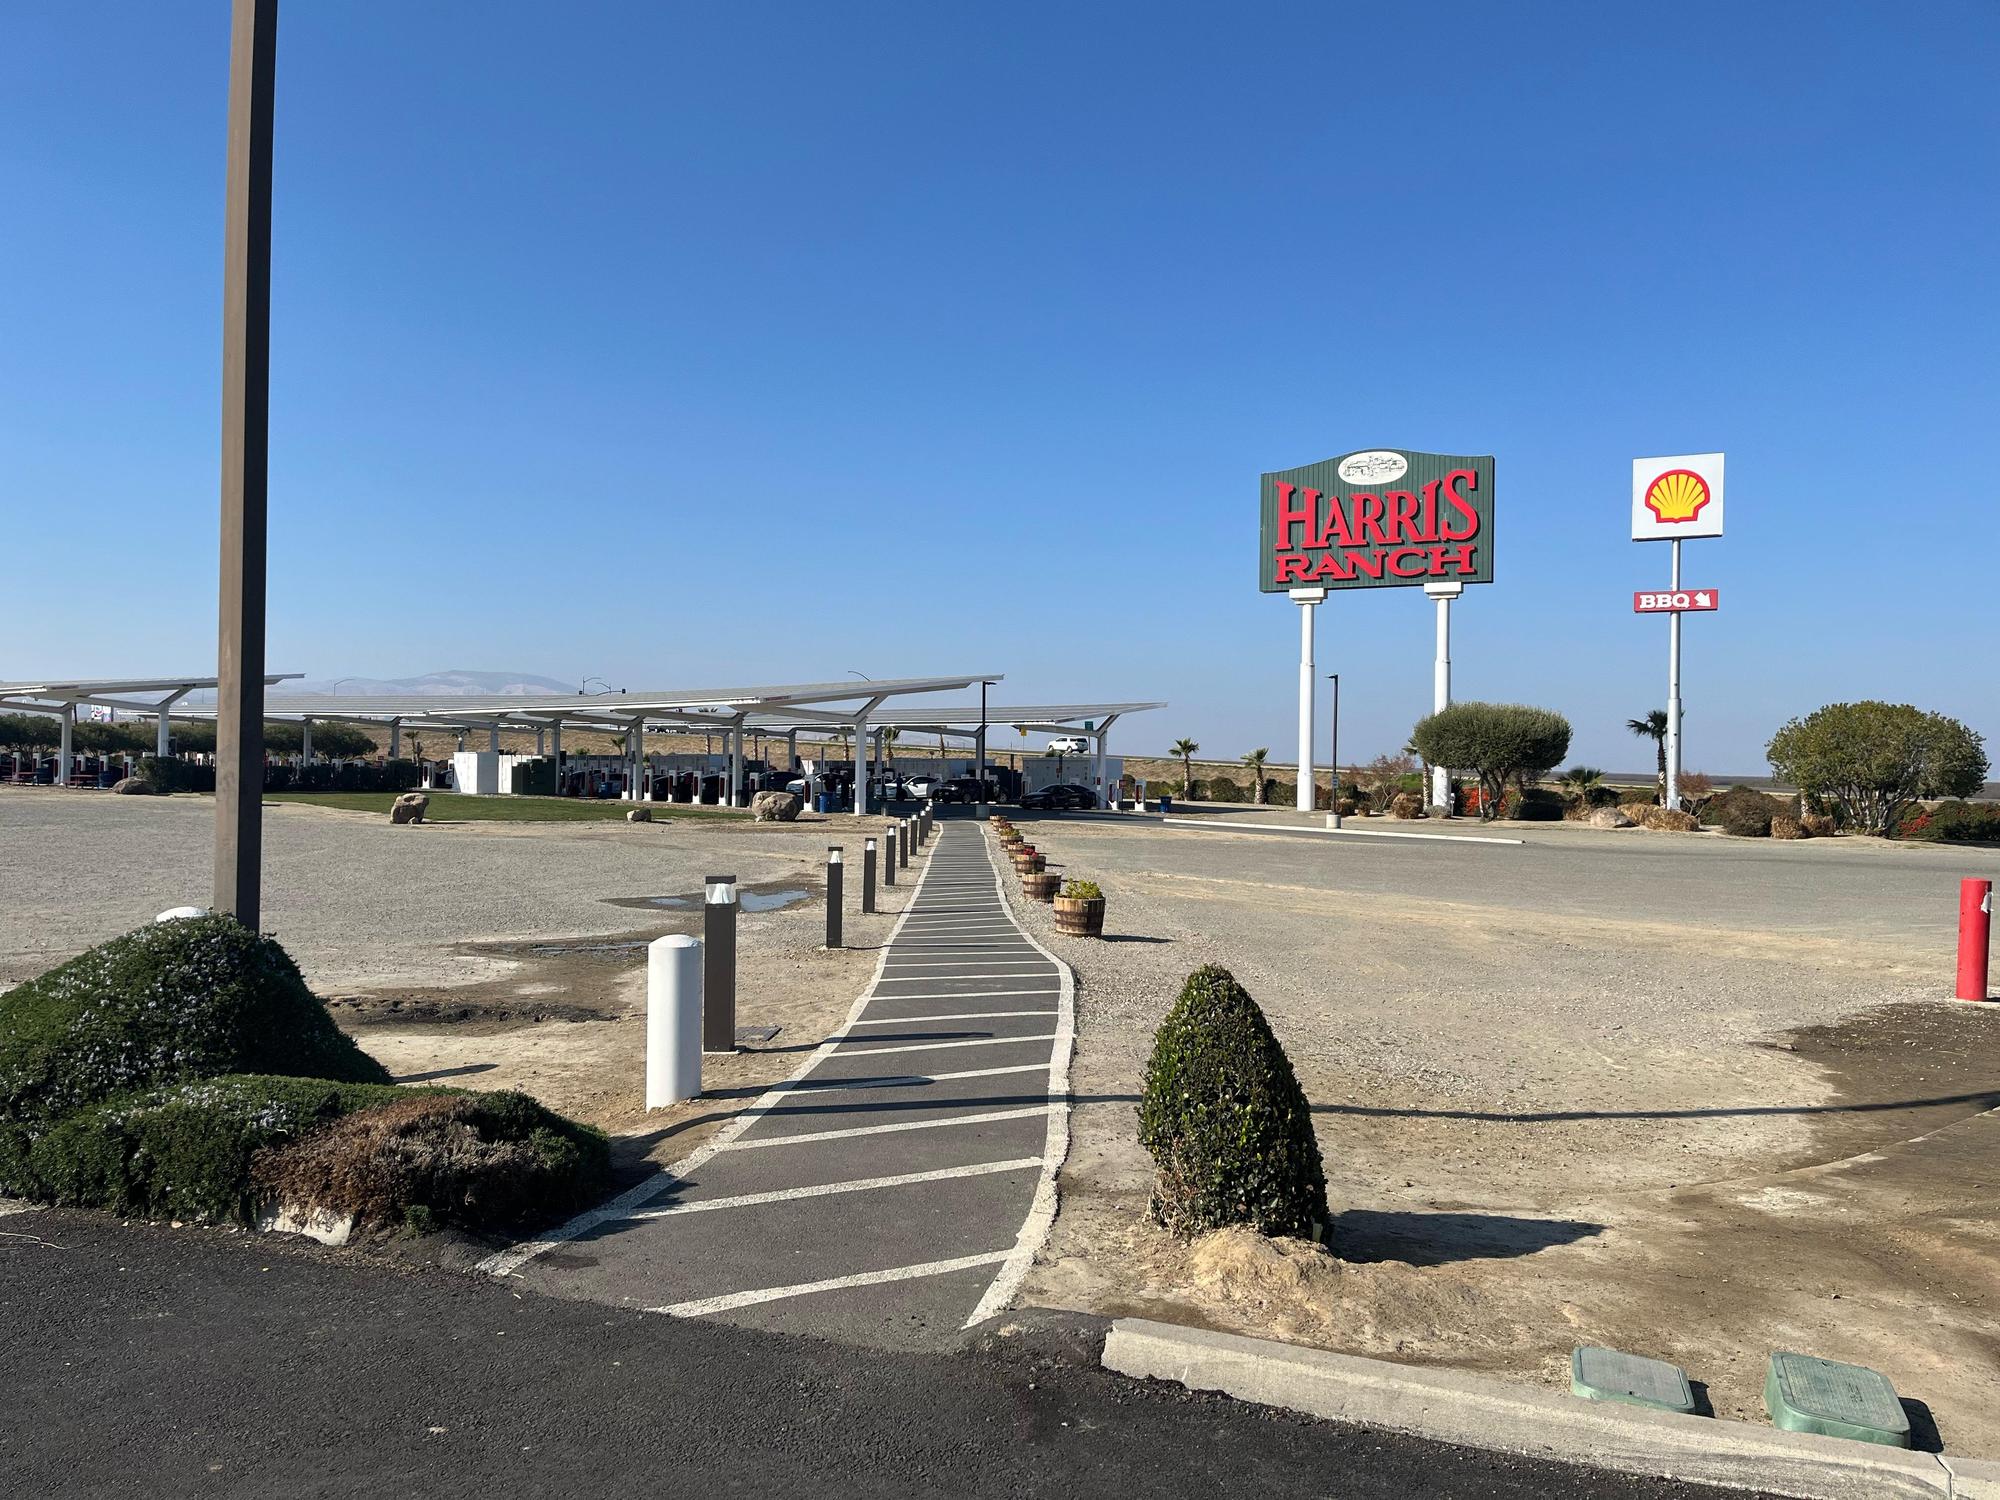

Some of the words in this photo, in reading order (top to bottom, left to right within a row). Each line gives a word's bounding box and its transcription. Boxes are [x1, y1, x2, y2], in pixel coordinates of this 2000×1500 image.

[1274, 469, 1479, 550] HARRIS
[1274, 544, 1477, 583] RANCH
[1639, 593, 1691, 609] BBQ
